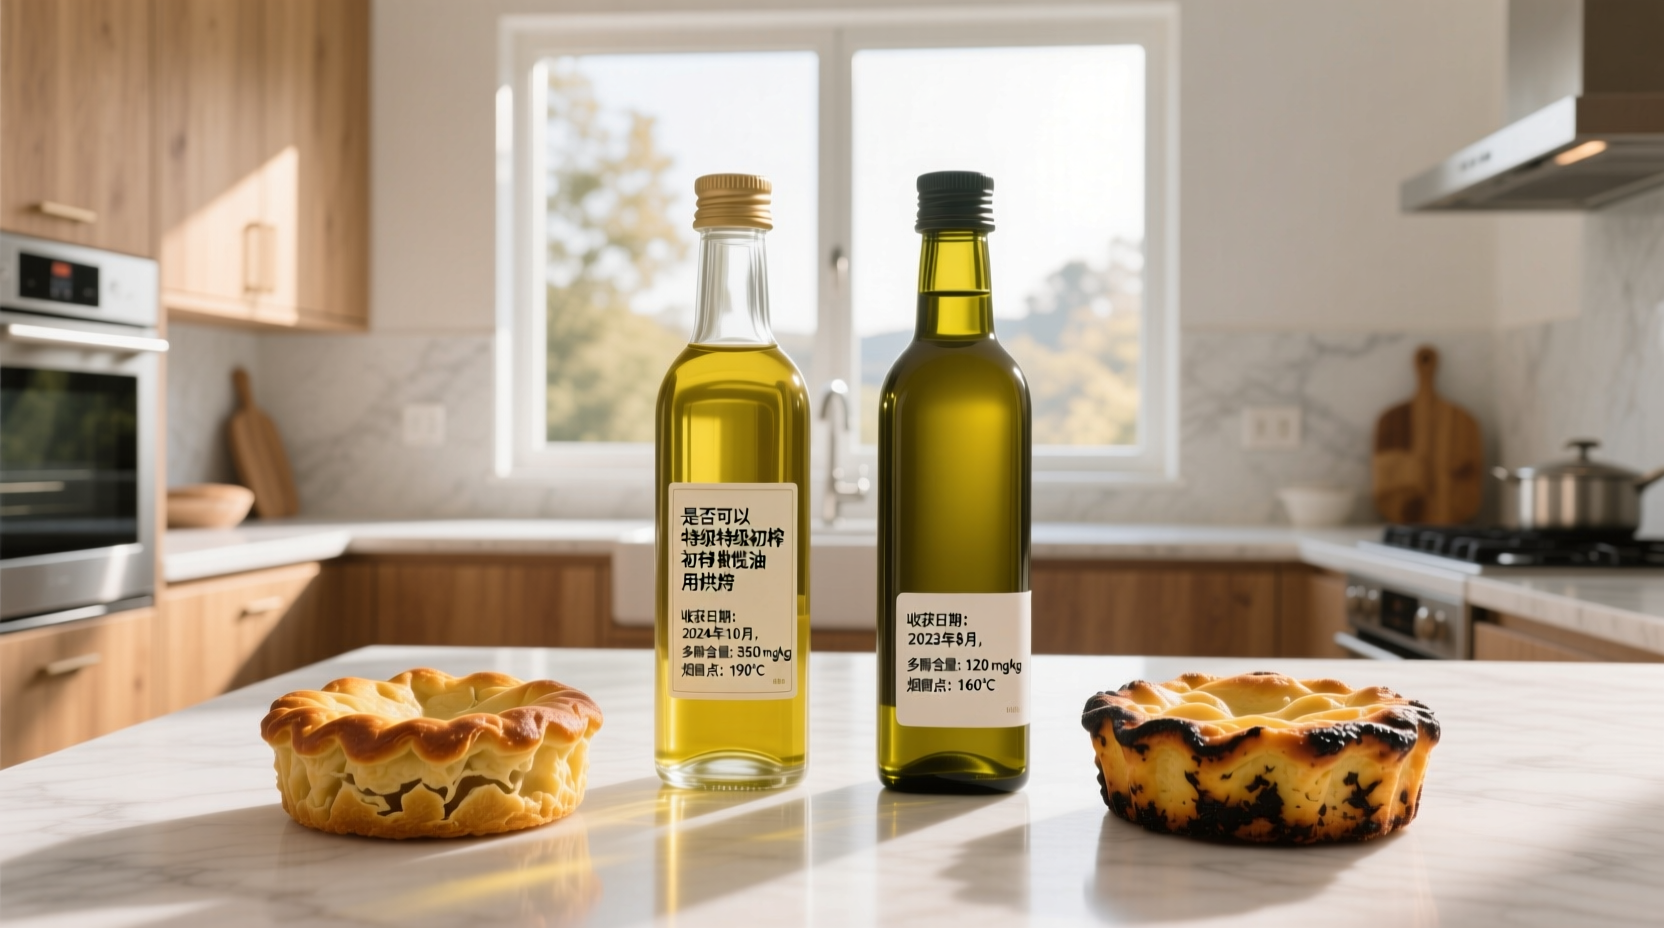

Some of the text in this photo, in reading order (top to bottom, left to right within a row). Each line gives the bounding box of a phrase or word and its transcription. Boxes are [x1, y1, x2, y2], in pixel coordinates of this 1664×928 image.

[680, 507, 750, 526] 是否可以
[737, 646, 761, 658] 350
[966, 659, 989, 671] 120
